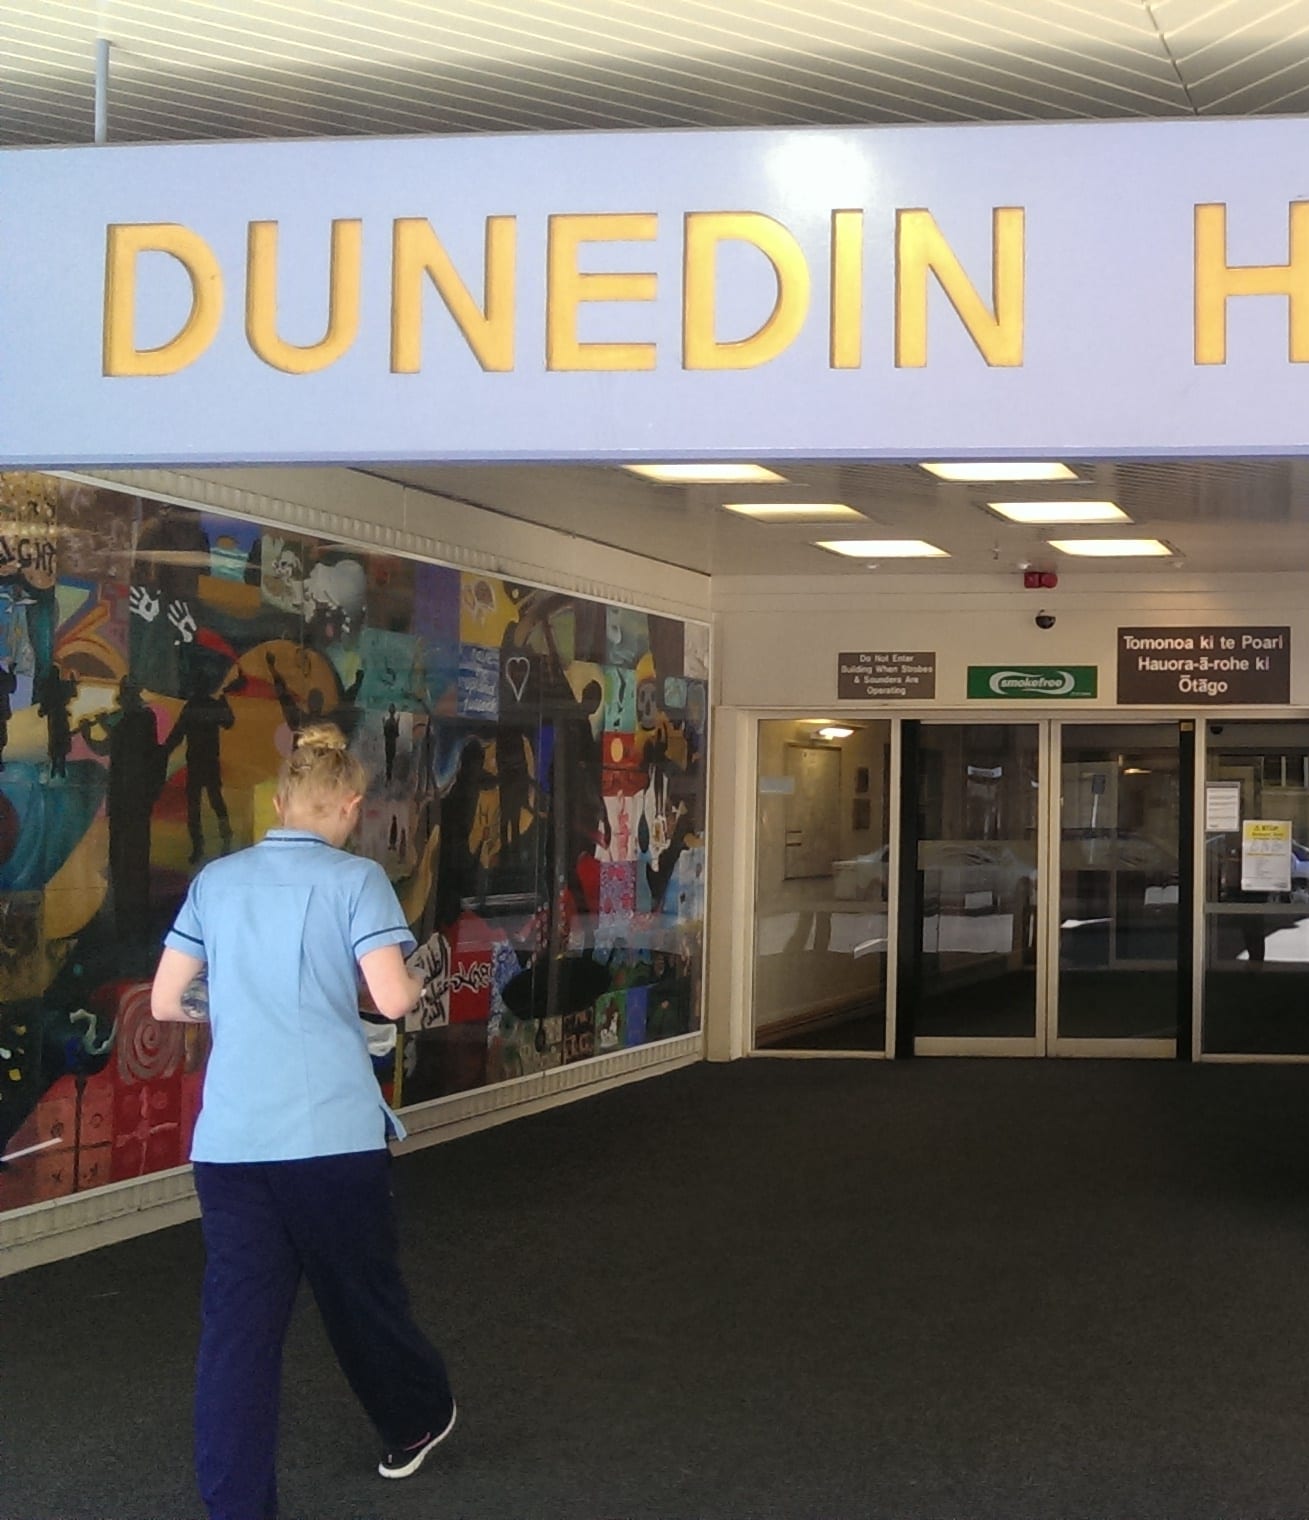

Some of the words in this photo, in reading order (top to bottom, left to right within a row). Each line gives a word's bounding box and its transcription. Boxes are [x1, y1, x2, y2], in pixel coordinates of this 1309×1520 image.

[102, 206, 1026, 378] DUNEDIN
[1123, 635, 1194, 650] Tomonoa
[1200, 634, 1214, 650] ki
[1220, 635, 1236, 650] te
[1241, 634, 1284, 650] Poari
[859, 654, 872, 662] Do
[874, 654, 889, 662] Not
[892, 654, 914, 662] Enter
[1137, 656, 1250, 671] Hauora-ā-rohe
[1255, 656, 1270, 671] ki
[840, 665, 873, 674] Building
[875, 665, 898, 673] When
[904, 675, 919, 684] Are
[1000, 677, 1063, 688] smokefree
[1178, 674, 1229, 696] Ōtāgo
[866, 686, 907, 695] Operating
